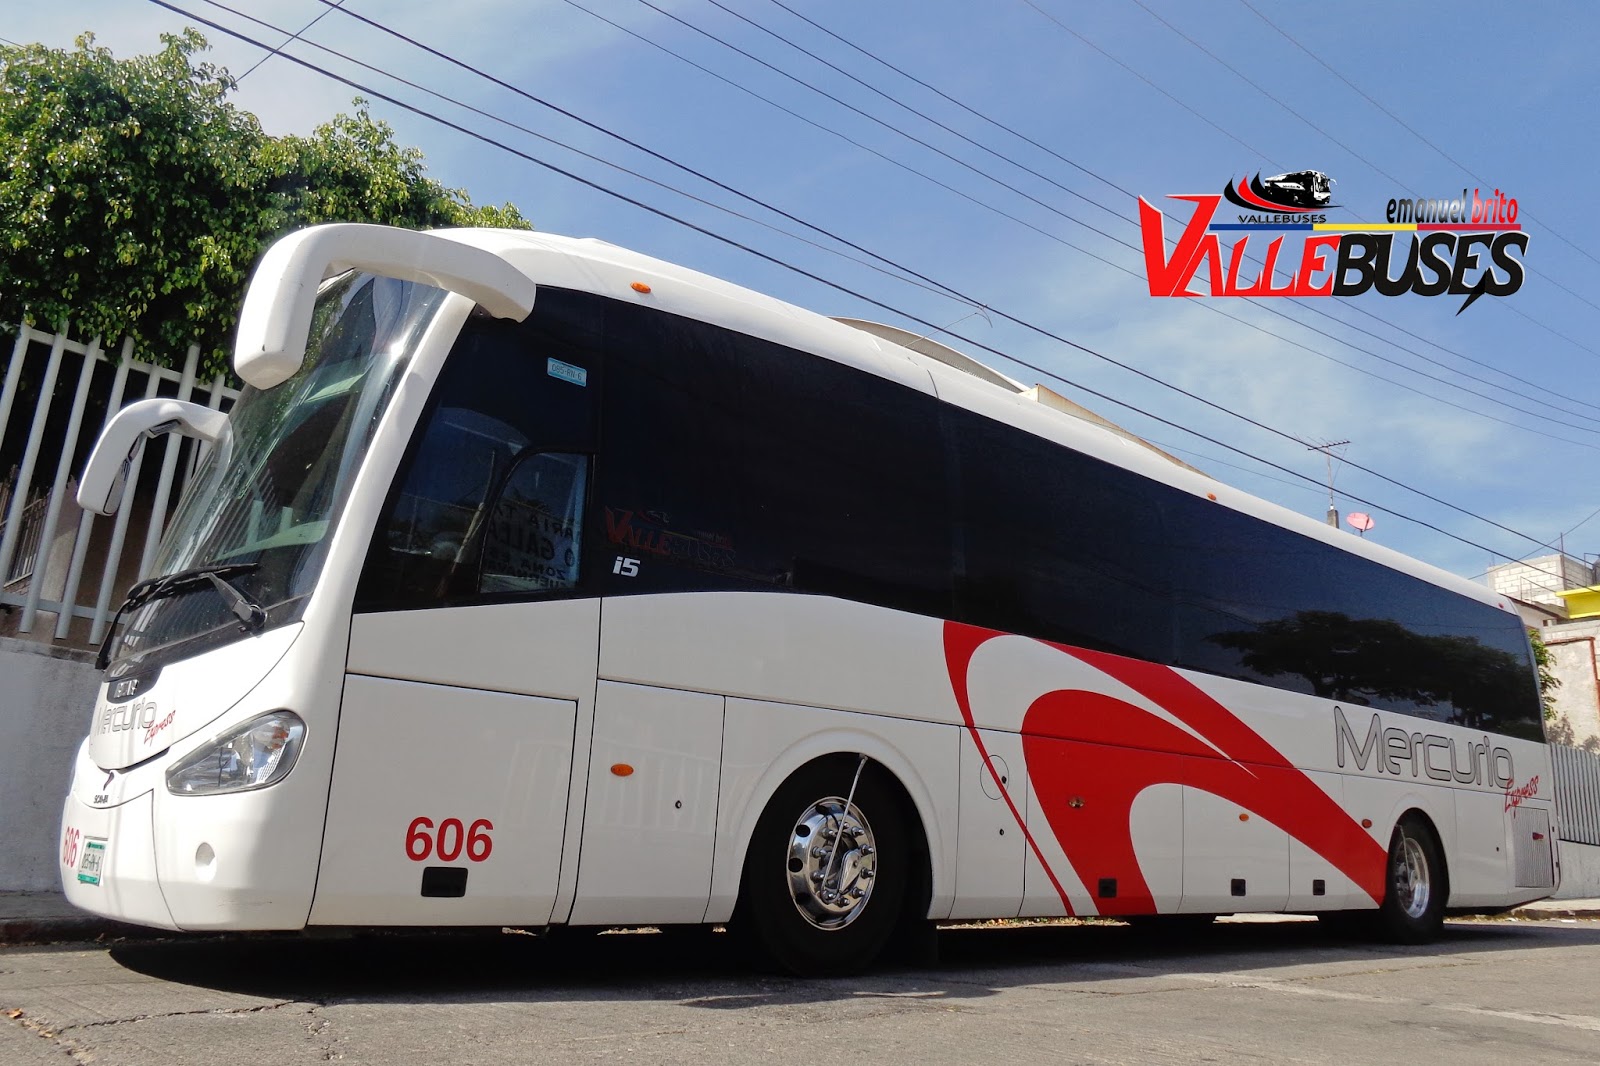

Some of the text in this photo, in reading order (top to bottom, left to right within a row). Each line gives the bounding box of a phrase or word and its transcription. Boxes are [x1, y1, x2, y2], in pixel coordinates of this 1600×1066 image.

[611, 555, 642, 578] i5
[1333, 705, 1515, 790] Mercurio
[405, 816, 494, 863] 606
